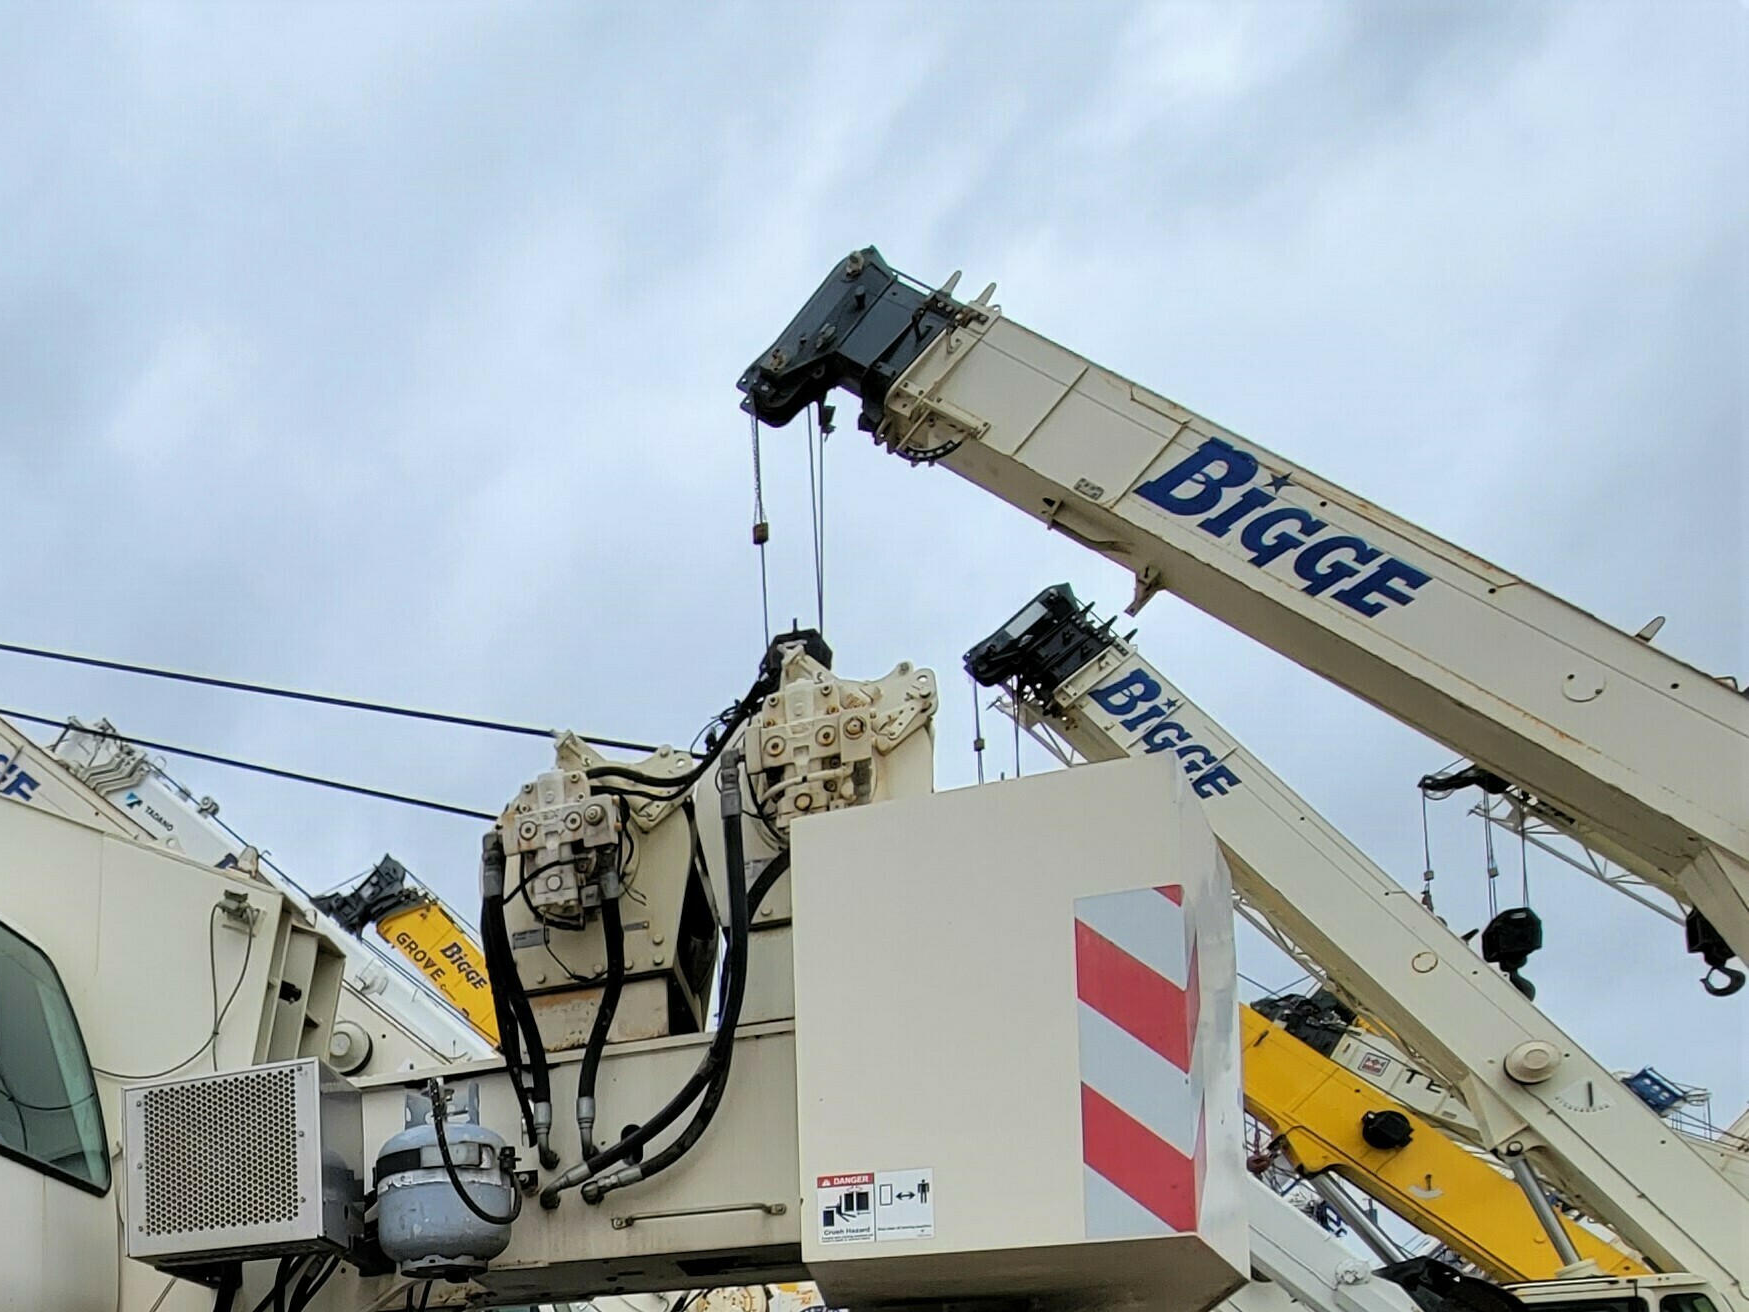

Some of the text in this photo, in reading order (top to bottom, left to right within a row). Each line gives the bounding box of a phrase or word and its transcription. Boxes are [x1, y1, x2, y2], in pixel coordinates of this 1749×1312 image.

[144, 805, 174, 832] TADANO
[396, 932, 446, 982] GROVE
[833, 1174, 869, 1186] DANGER
